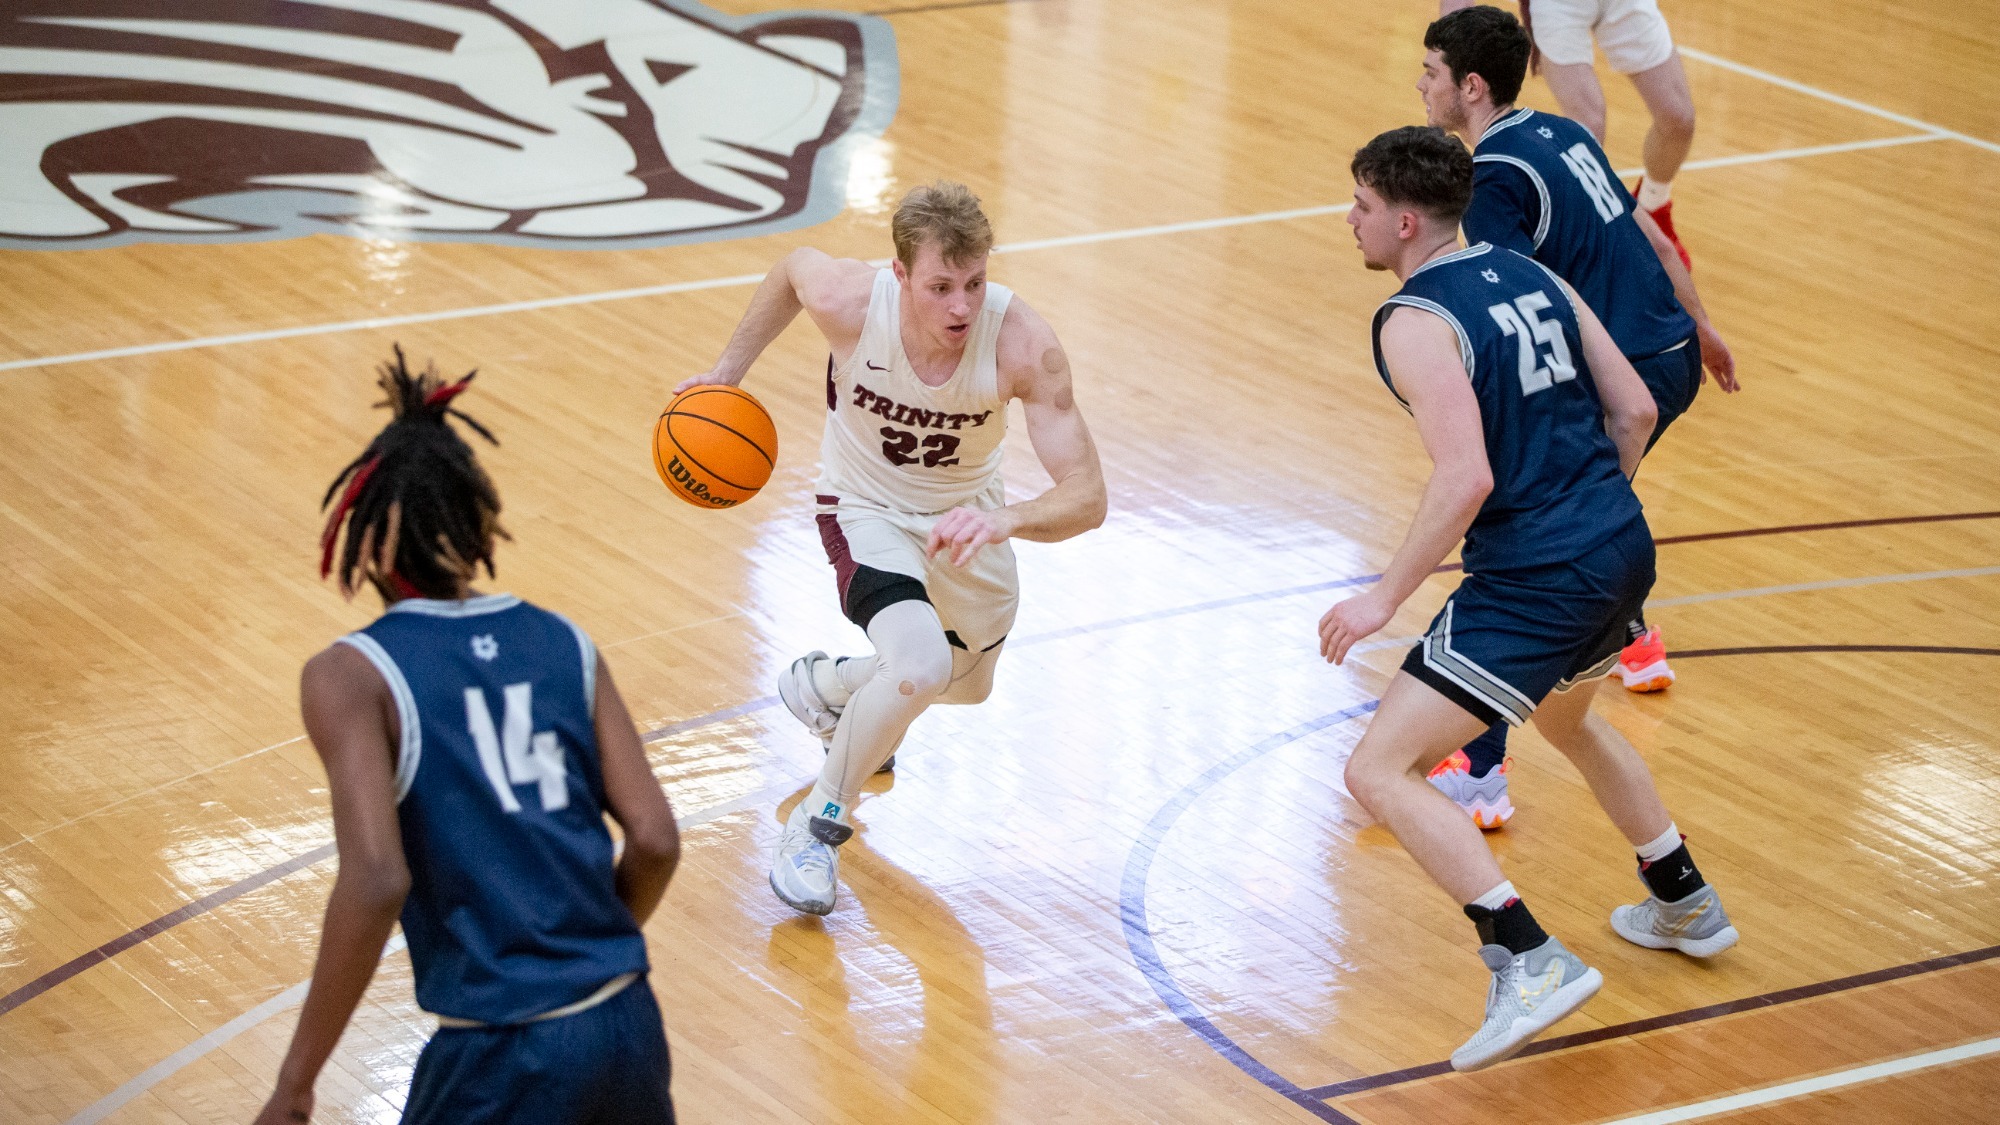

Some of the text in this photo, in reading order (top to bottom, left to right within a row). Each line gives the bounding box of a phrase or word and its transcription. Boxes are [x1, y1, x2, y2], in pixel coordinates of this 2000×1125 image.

[1488, 290, 1576, 397] 25
[852, 383, 993, 431] TRINITY
[880, 427, 962, 468] 22
[668, 454, 738, 507] Wilson
[464, 682, 569, 813] 14
